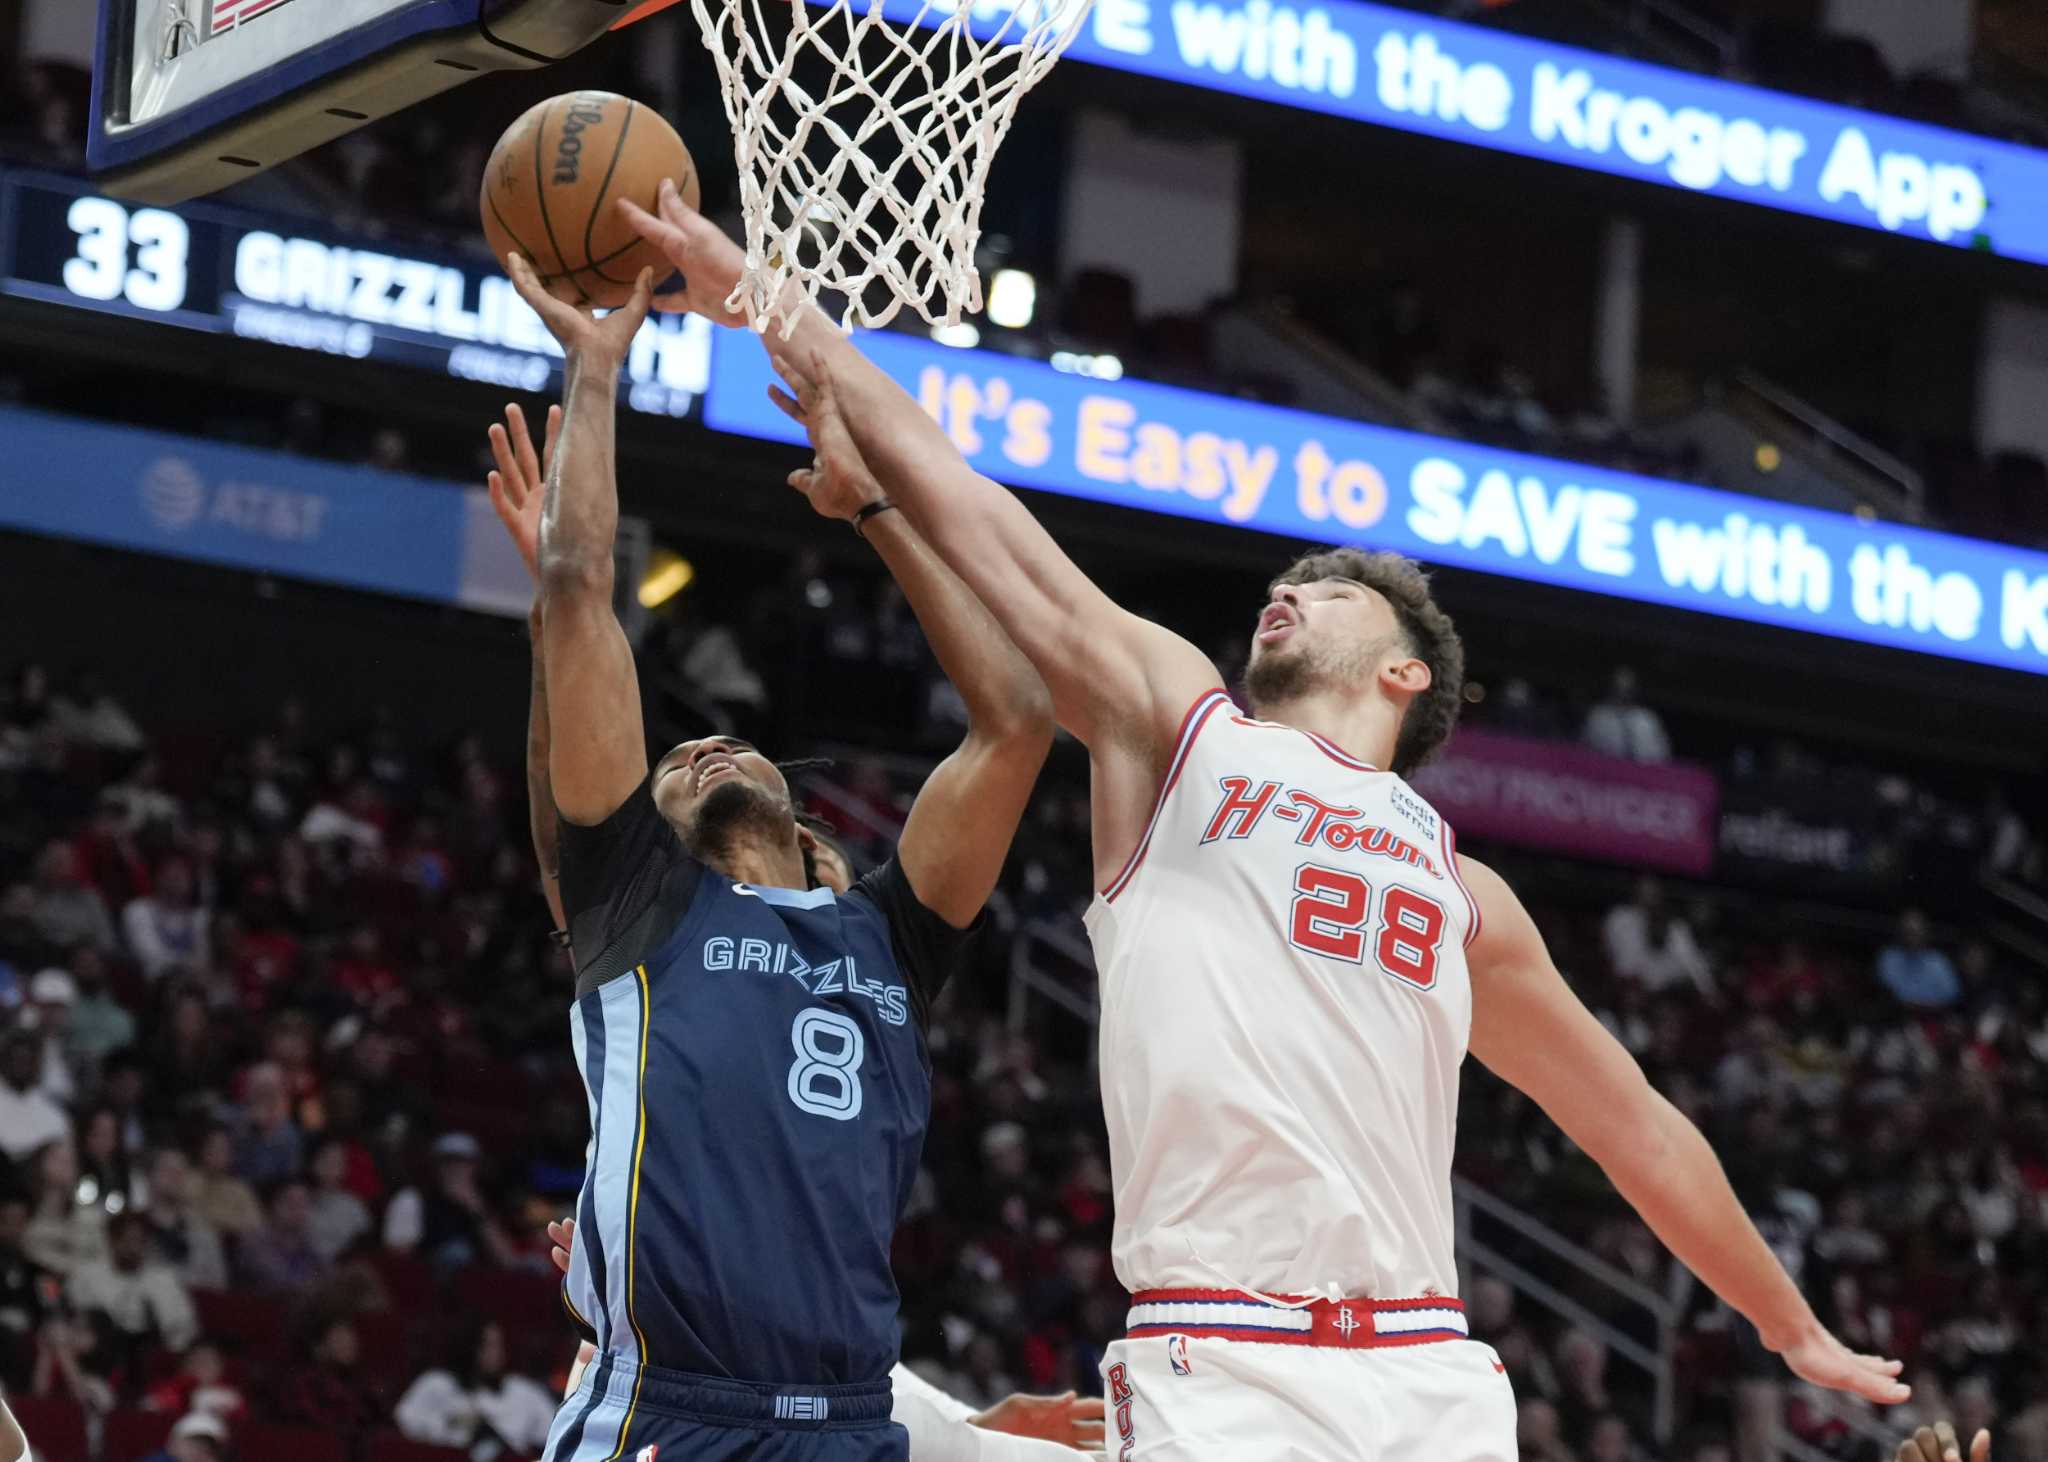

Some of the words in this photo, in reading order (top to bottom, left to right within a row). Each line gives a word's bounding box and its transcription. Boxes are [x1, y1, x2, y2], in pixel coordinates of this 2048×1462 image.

[1169, 0, 1357, 98] with
[1374, 29, 1513, 131] the
[1530, 60, 1807, 191] Kroger
[1817, 127, 1987, 242] App
[62, 196, 190, 312] 33
[234, 230, 567, 359] GRIZZLIE
[919, 364, 1052, 468] It's
[1075, 395, 1280, 523] Easy
[1294, 439, 1389, 530] to
[1406, 458, 1639, 578] SAVE
[1652, 513, 1833, 615] with
[1849, 542, 1984, 642] the
[1393, 802, 1436, 842] arma
[1289, 862, 1448, 991] 28
[787, 1007, 864, 1121] 8
